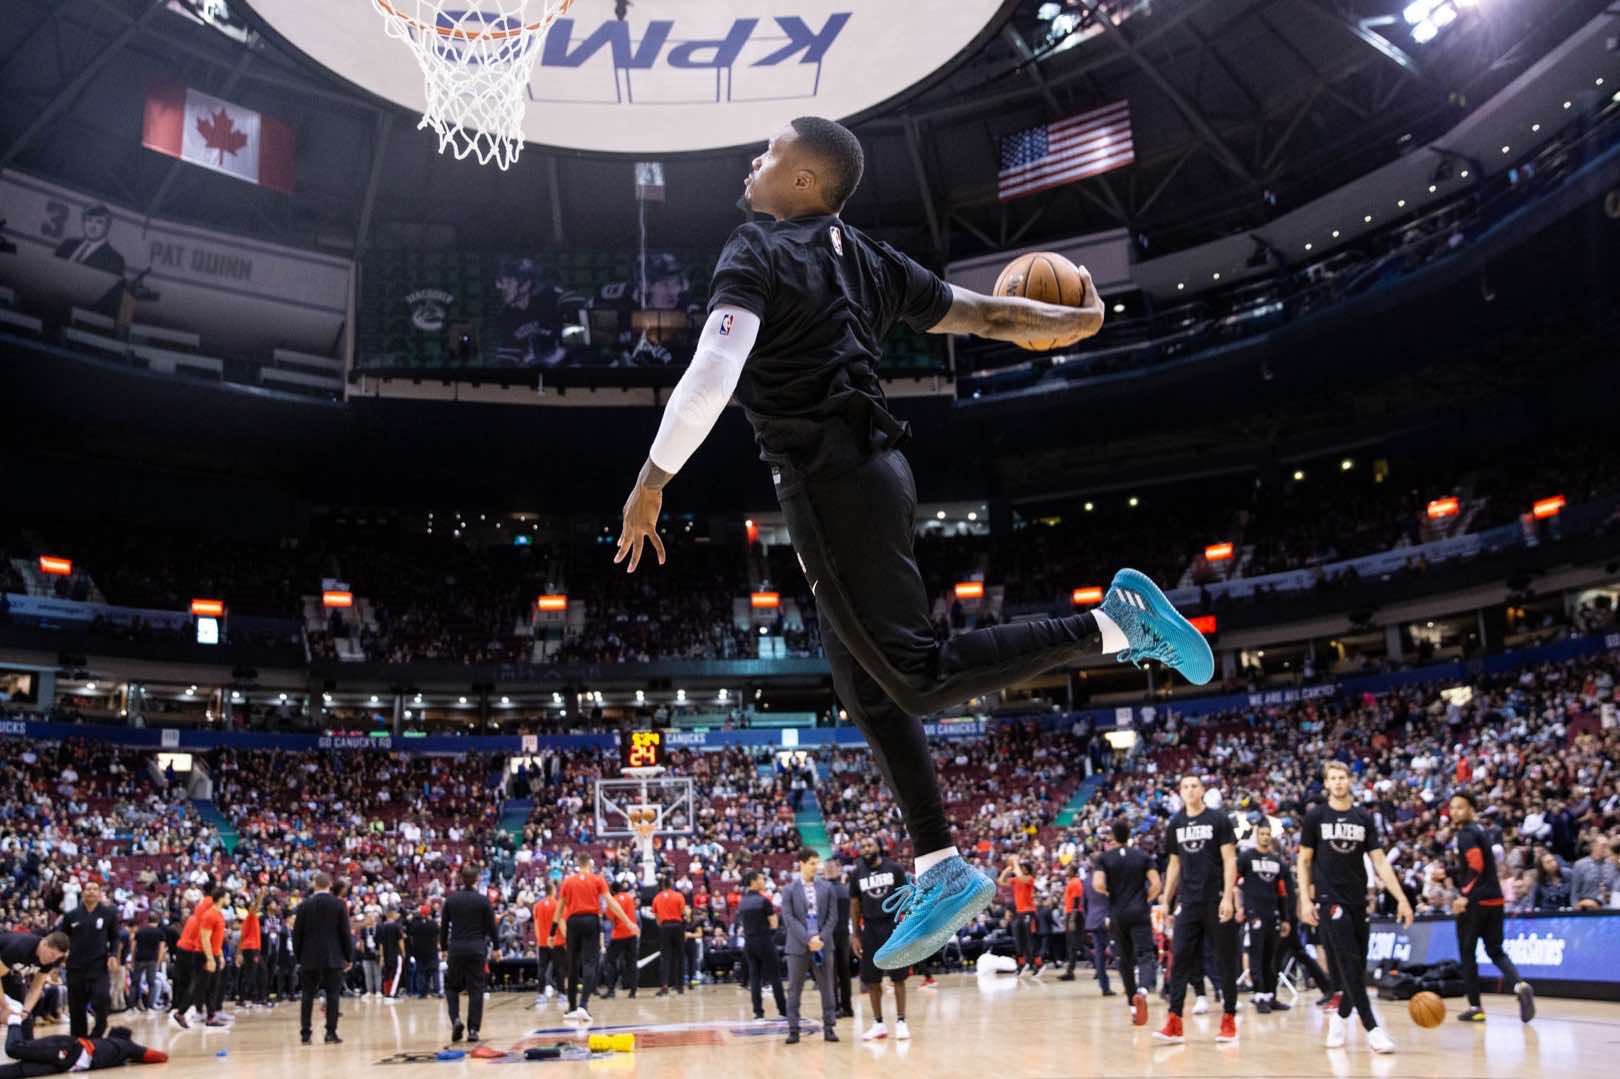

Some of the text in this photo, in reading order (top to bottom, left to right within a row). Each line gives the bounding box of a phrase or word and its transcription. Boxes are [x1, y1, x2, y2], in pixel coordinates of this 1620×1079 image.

[40, 201, 70, 238] 3
[149, 239, 254, 281] PAT QUINN
[665, 733, 706, 745] CANUCKS
[937, 723, 977, 735] CANUCKS
[630, 745, 655, 766] 24
[1176, 824, 1214, 844] BLAZERS
[1320, 822, 1366, 843] BLAZERS
[1251, 859, 1281, 873] BLAZERS
[859, 872, 895, 892] BLAZERS
